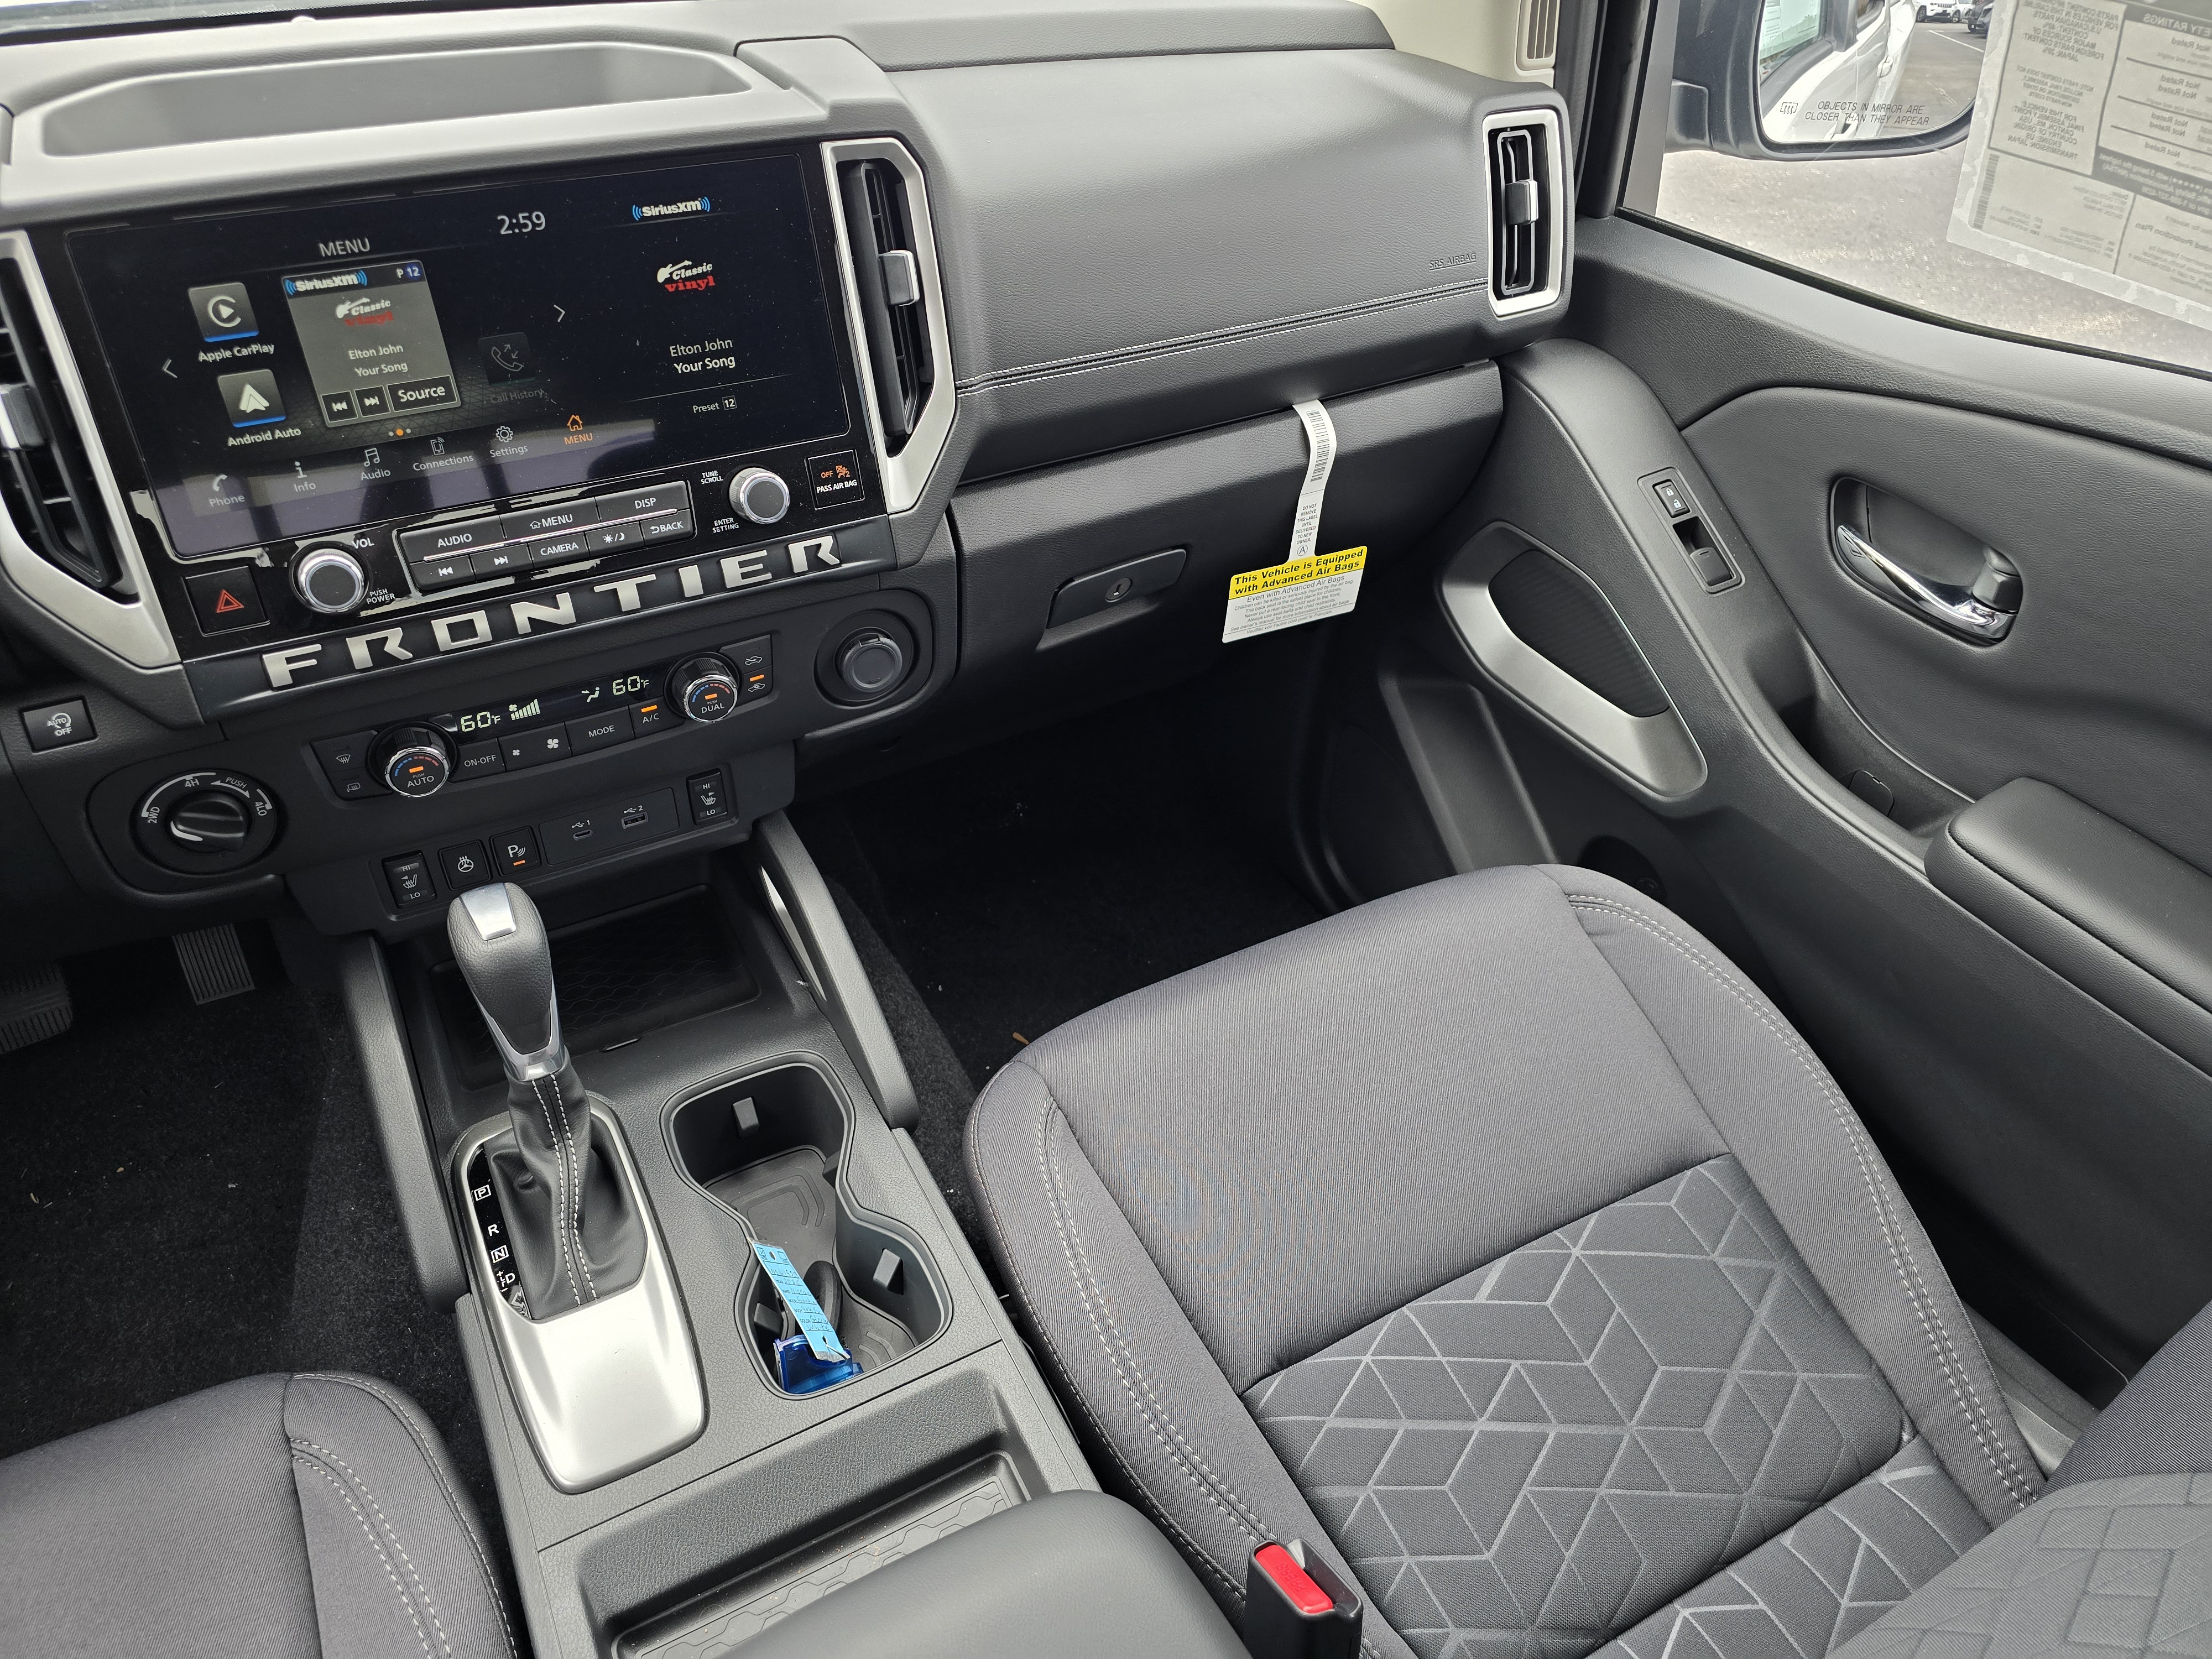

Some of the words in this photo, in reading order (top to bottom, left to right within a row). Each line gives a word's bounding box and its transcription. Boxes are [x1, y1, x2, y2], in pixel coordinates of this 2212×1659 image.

[1818, 101, 1858, 111] OBJECTS
[1860, 103, 1869, 112] IN
[1871, 103, 1903, 113] MIRROR
[1907, 105, 1925, 114] ARE
[1805, 111, 1839, 121] CLOSER
[1845, 113, 1866, 122] THAN
[1870, 114, 1891, 124] THEY
[1893, 116, 1929, 126] APPEAR
[641, 199, 702, 217] SiriusXM
[498, 211, 546, 235] 2:59
[319, 238, 371, 257] MENU
[1429, 258, 1444, 269] SRS
[1447, 252, 1477, 265] AIRBAG
[295, 273, 358, 291] SiriusXM
[397, 268, 404, 278] P
[407, 267, 420, 277] 12
[672, 263, 713, 280] Classic
[665, 276, 716, 292] vinyl
[351, 299, 392, 316] Classic
[198, 348, 232, 363] Apple
[233, 343, 274, 358] CarPlay
[348, 346, 376, 360] Elton
[377, 343, 404, 357] John
[670, 341, 702, 357] Elton
[705, 338, 733, 353] John
[354, 364, 379, 377] Your
[381, 361, 408, 374] Song
[674, 360, 703, 374] Your
[706, 356, 736, 372] Song
[398, 384, 445, 403] Source
[490, 393, 509, 404] Call
[510, 387, 544, 403] History
[693, 401, 719, 414] Preset
[724, 398, 735, 409] 12
[227, 431, 272, 446] Android
[275, 427, 301, 439] Auto
[564, 432, 593, 446] MENU
[490, 444, 528, 458] Settings
[413, 453, 474, 471] Connections
[361, 467, 391, 481] Audio
[701, 470, 718, 479] TUNE
[701, 475, 723, 484] SCROLL
[821, 471, 833, 479] OFF
[294, 480, 316, 492] Info
[816, 483, 832, 493] PASS
[833, 482, 844, 491] AIR
[844, 479, 857, 489] BAG
[208, 493, 245, 508] Phone
[634, 497, 656, 509] DISP
[541, 513, 573, 528] MENU
[659, 520, 684, 532] BACK
[714, 518, 734, 528] ENTER
[712, 523, 739, 534] SETTING
[1296, 525, 1316, 534] DELIVERED
[351, 538, 375, 549] VOL
[437, 533, 472, 547] AUDIO
[540, 541, 579, 556] CAMERA
[1235, 574, 1257, 585] This
[1261, 564, 1300, 578] Vehicle
[1316, 549, 1363, 566] Equipped
[1235, 583, 1258, 594] with
[1261, 570, 1313, 588] Advanced
[1316, 567, 1331, 576] Air
[1334, 561, 1359, 572] Bags
[369, 588, 388, 598] PUSH
[1247, 593, 1264, 603] Even
[1266, 589, 1280, 598] with
[1281, 581, 1314, 594] Advanced
[1328, 575, 1344, 584] Bags
[1288, 589, 1307, 598] seriously
[367, 592, 395, 604] POWER
[262, 535, 840, 687] FRONTIER
[701, 703, 725, 713] DUAL
[47, 717, 67, 728] AUTO
[641, 712, 660, 724] A/C
[55, 726, 72, 736] OFF
[588, 725, 615, 737] MODE
[184, 777, 200, 787] 4H
[226, 775, 248, 790] PUSH
[406, 775, 435, 787] AUTO
[147, 806, 160, 824] 2WD
[254, 801, 267, 817] 4LO
[508, 844, 518, 858] P
[488, 1224, 499, 1236] R
[505, 1272, 515, 1284] D
[1275, 1562, 1307, 1593] PRESS
